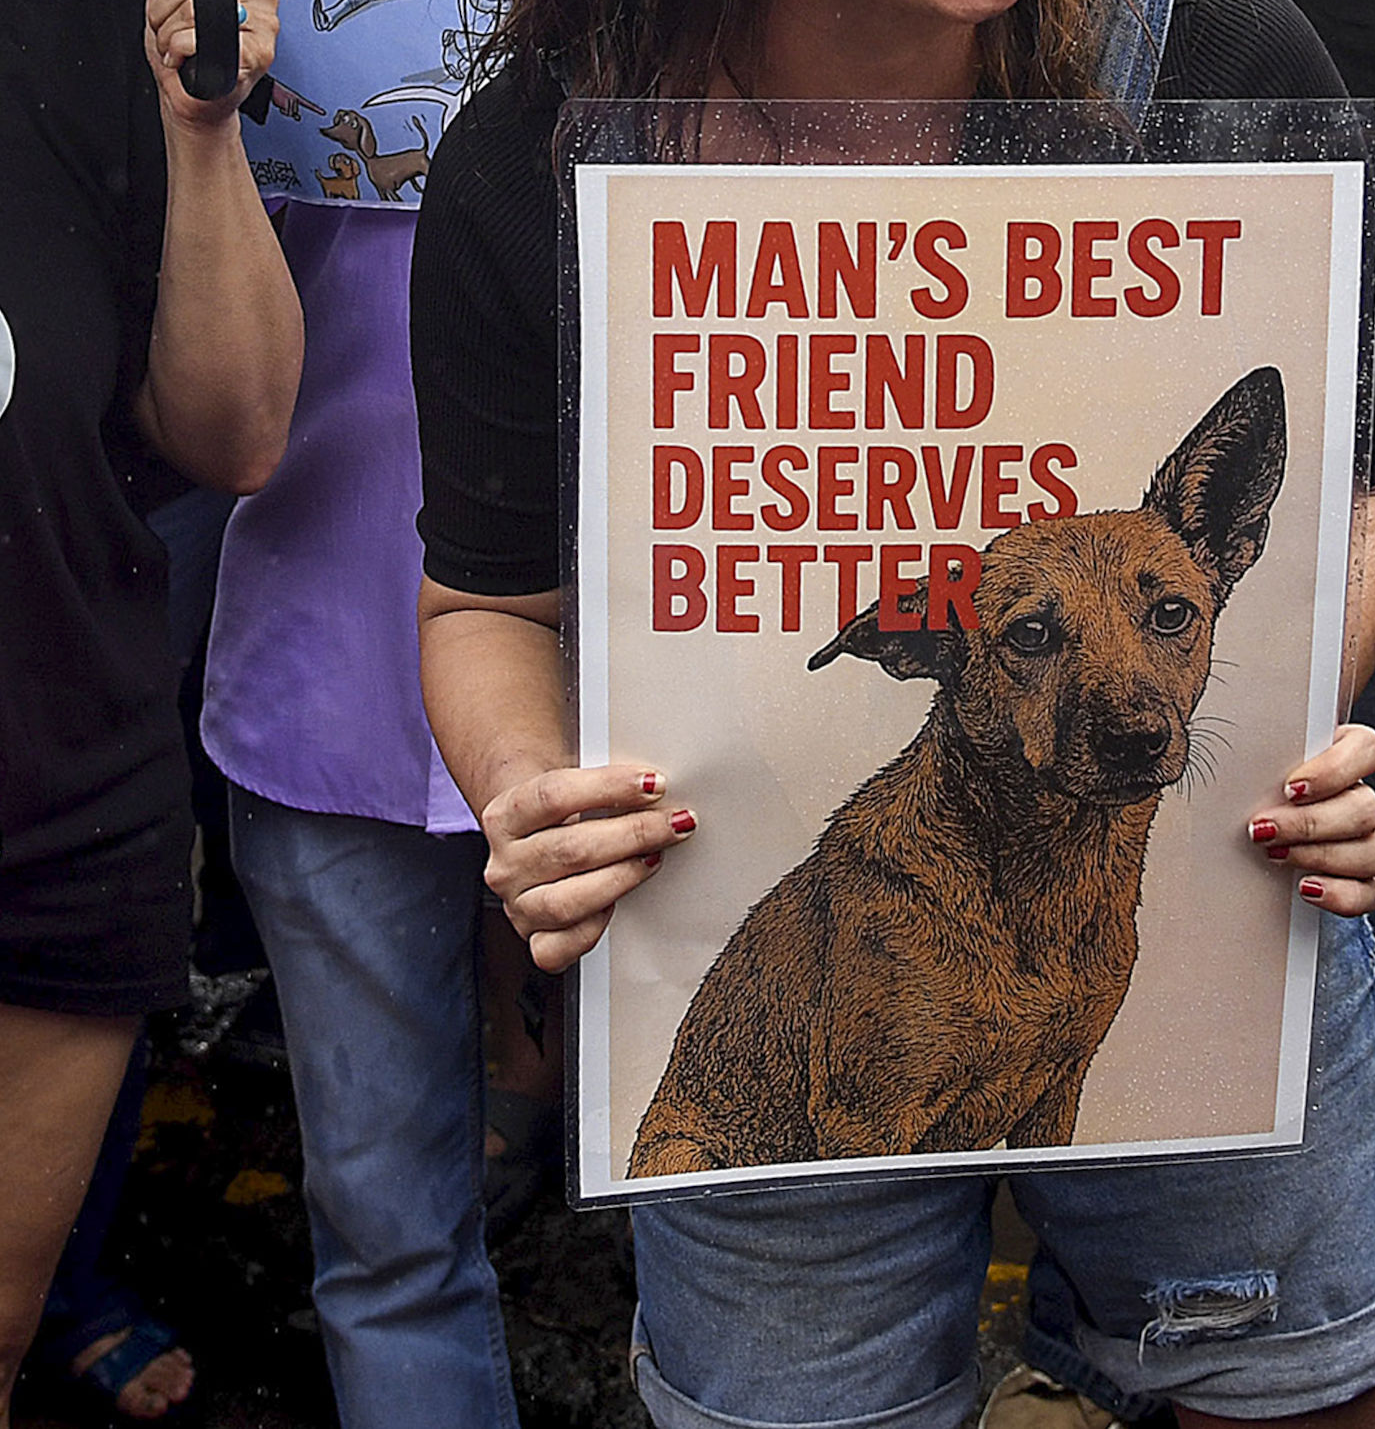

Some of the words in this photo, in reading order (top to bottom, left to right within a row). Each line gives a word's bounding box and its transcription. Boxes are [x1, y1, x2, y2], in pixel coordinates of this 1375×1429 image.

[651, 219, 970, 320] MAN'S
[1005, 219, 1243, 319] BEST
[651, 332, 996, 431] FRIEND
[651, 443, 1079, 532] DESERVES
[651, 542, 983, 633] BETTER
